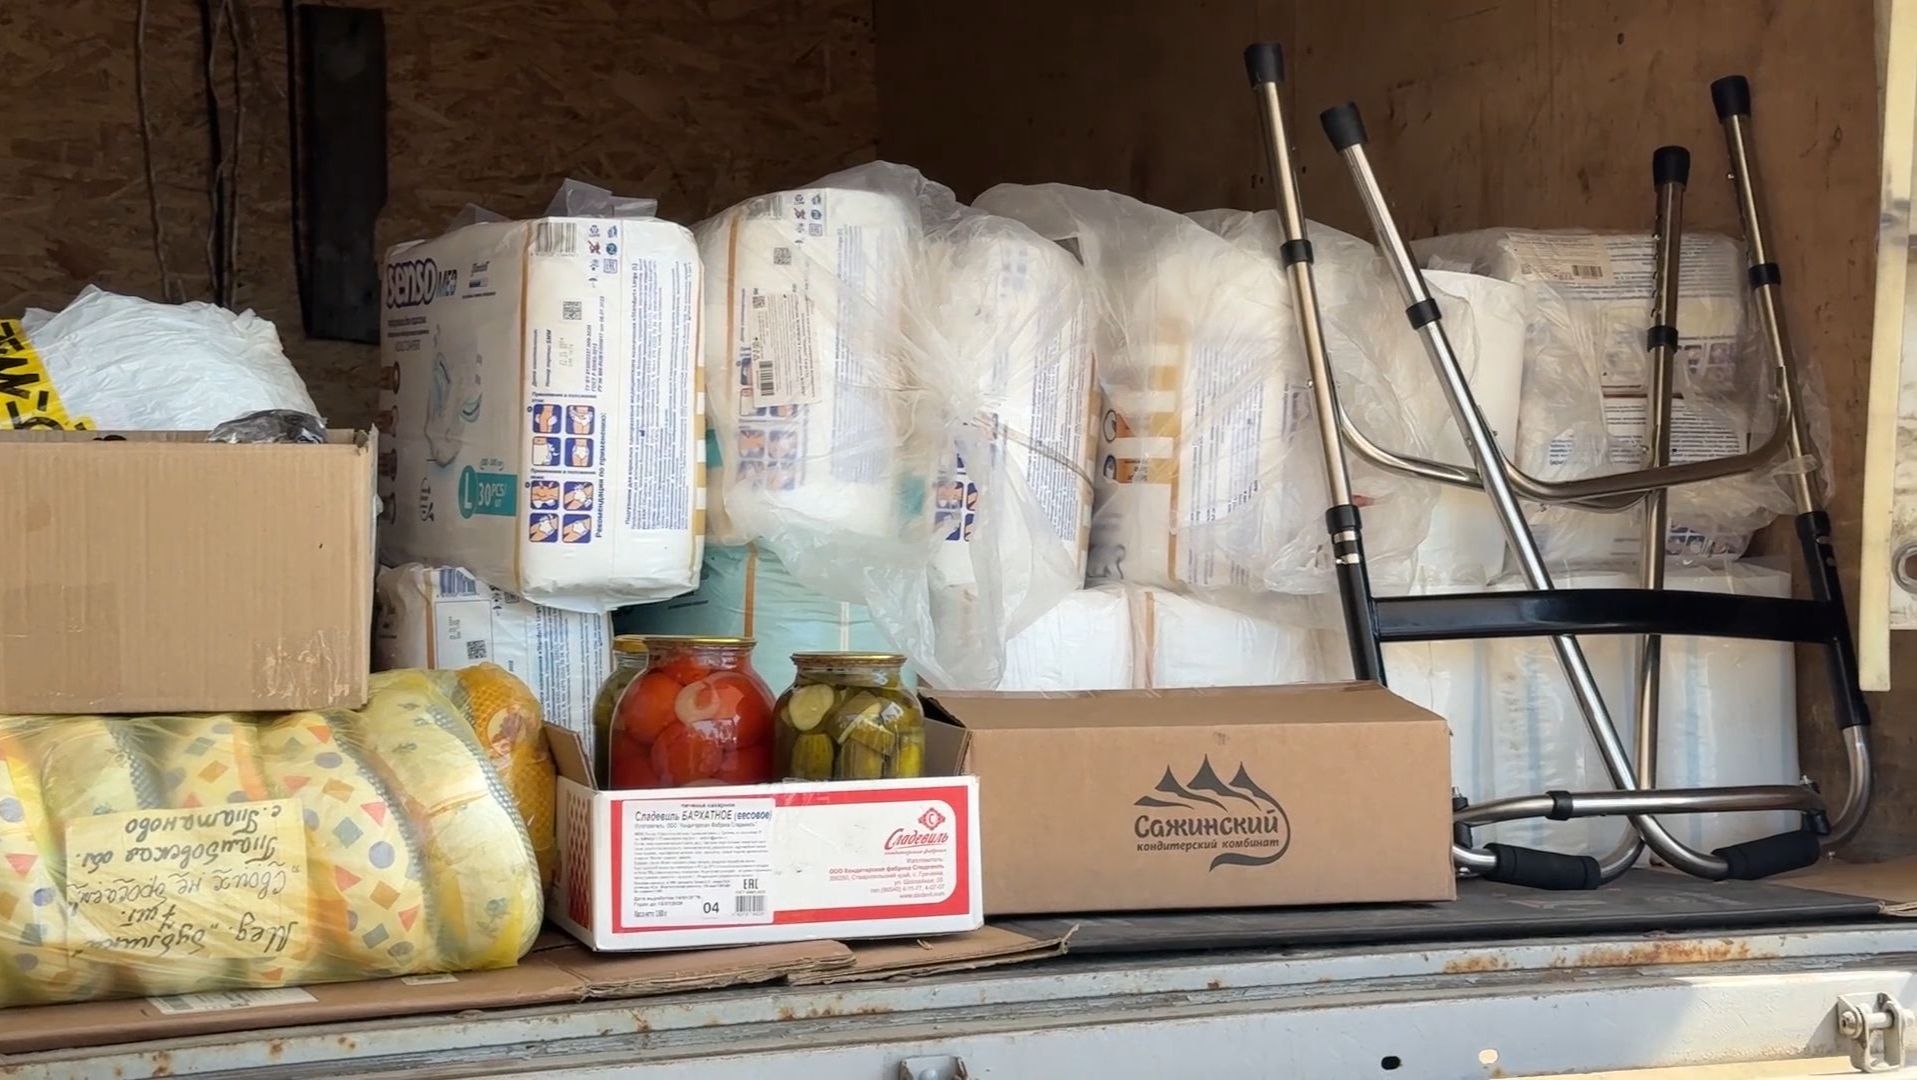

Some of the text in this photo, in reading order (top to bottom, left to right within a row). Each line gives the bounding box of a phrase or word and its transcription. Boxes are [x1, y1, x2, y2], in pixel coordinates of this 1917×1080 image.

[464, 472, 473, 509] L
[479, 482, 492, 507] 30
[634, 811, 680, 822] Сладевиль
[682, 810, 732, 821] БАРХАТНОЕ
[1134, 809, 1279, 838] Сажинский
[884, 828, 949, 850] Сладевиль
[1137, 838, 1280, 852] кондитерский комбинат
[176, 874, 201, 896] не
[703, 902, 719, 914] 04
